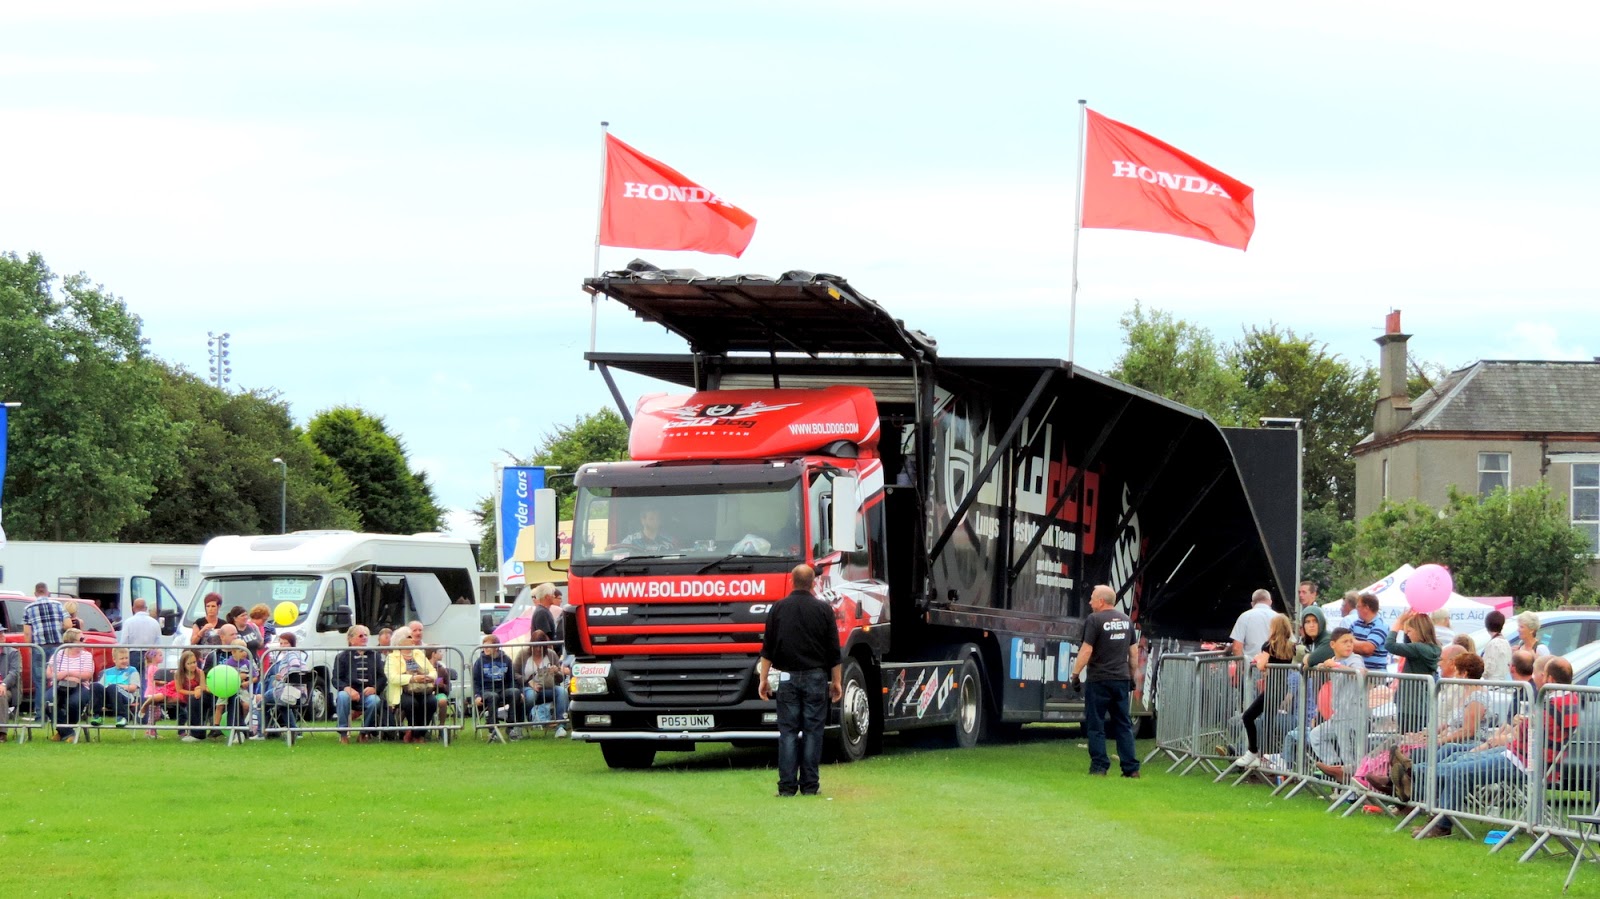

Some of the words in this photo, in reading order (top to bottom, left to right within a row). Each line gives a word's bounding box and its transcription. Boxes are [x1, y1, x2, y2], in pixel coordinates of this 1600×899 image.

[1112, 160, 1232, 199] HONDA
[788, 422, 859, 435] WWW.BOLDDOG.COM
[516, 471, 528, 498] Cars
[514, 501, 529, 531] rder
[1055, 525, 1076, 551] Team
[600, 579, 765, 598] WWW.BOLDDOG.COM
[588, 606, 629, 616] DAF
[1467, 610, 1485, 620] Aid
[1103, 621, 1130, 631] CREW
[580, 666, 607, 675] Castrol
[690, 716, 710, 726] UNK
